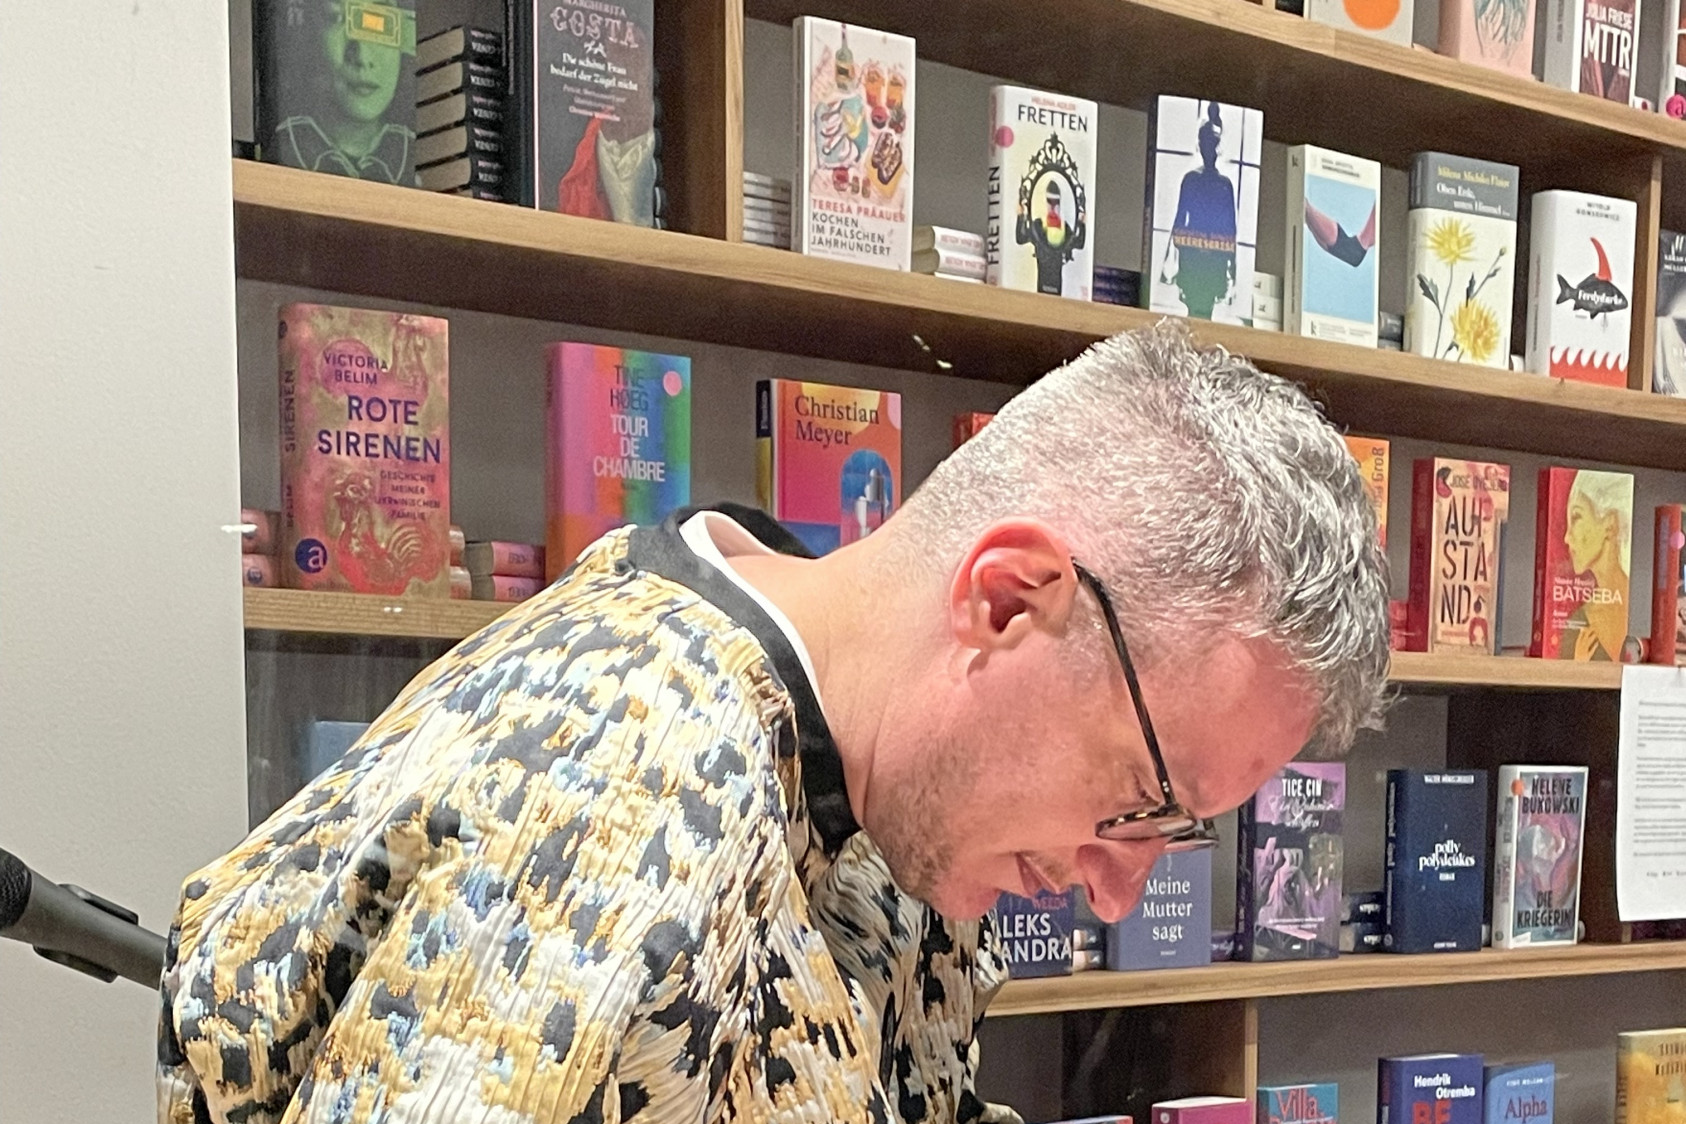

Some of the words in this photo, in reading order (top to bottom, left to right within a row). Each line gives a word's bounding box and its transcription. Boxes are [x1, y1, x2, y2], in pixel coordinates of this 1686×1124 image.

[550, 6, 639, 48] COSTA
[1584, 19, 1631, 69] MTTR
[1018, 104, 1087, 133] FRETTEN
[812, 199, 853, 215] TERESA
[857, 205, 905, 222] PRÄAUER
[812, 211, 859, 228] KOCHEN
[987, 165, 1000, 265] FRETTEN
[812, 223, 825, 235] IM
[829, 226, 885, 244] FALSCHEN
[811, 235, 891, 256] JAHRHUNDERT
[322, 352, 389, 372] VICTORIA
[334, 369, 379, 386] BELIM
[284, 370, 297, 453] SIRENEN
[347, 394, 420, 427] ROTE
[794, 394, 881, 426] Christian
[610, 413, 650, 438] TOUR
[794, 419, 853, 449] Meyer
[318, 429, 442, 465] SIRENEN
[619, 437, 640, 459] DE
[593, 455, 666, 483] CHAMBRE
[1442, 540, 1488, 582] STA
[1440, 583, 1472, 626] ND
[1552, 585, 1623, 606] BATSEBA
[1282, 778, 1303, 797] TICE
[1306, 778, 1322, 797] CIN
[1531, 777, 1573, 796] HELENE
[1522, 796, 1580, 815] BUKOWSKI
[1434, 839, 1461, 855] polly
[1145, 876, 1191, 896] Meine
[1142, 900, 1193, 919] Mutter
[1536, 889, 1553, 910] DIE
[998, 912, 1052, 939] LEKS
[1516, 909, 1575, 929] KRIEGERIN
[1152, 923, 1184, 943] sagt
[1001, 936, 1072, 964] ANDRA
[1414, 1073, 1451, 1089] Hendrik
[1436, 1085, 1476, 1100] Otremba
[1274, 1087, 1319, 1121] Villa
[1504, 1094, 1548, 1124] Alpha
